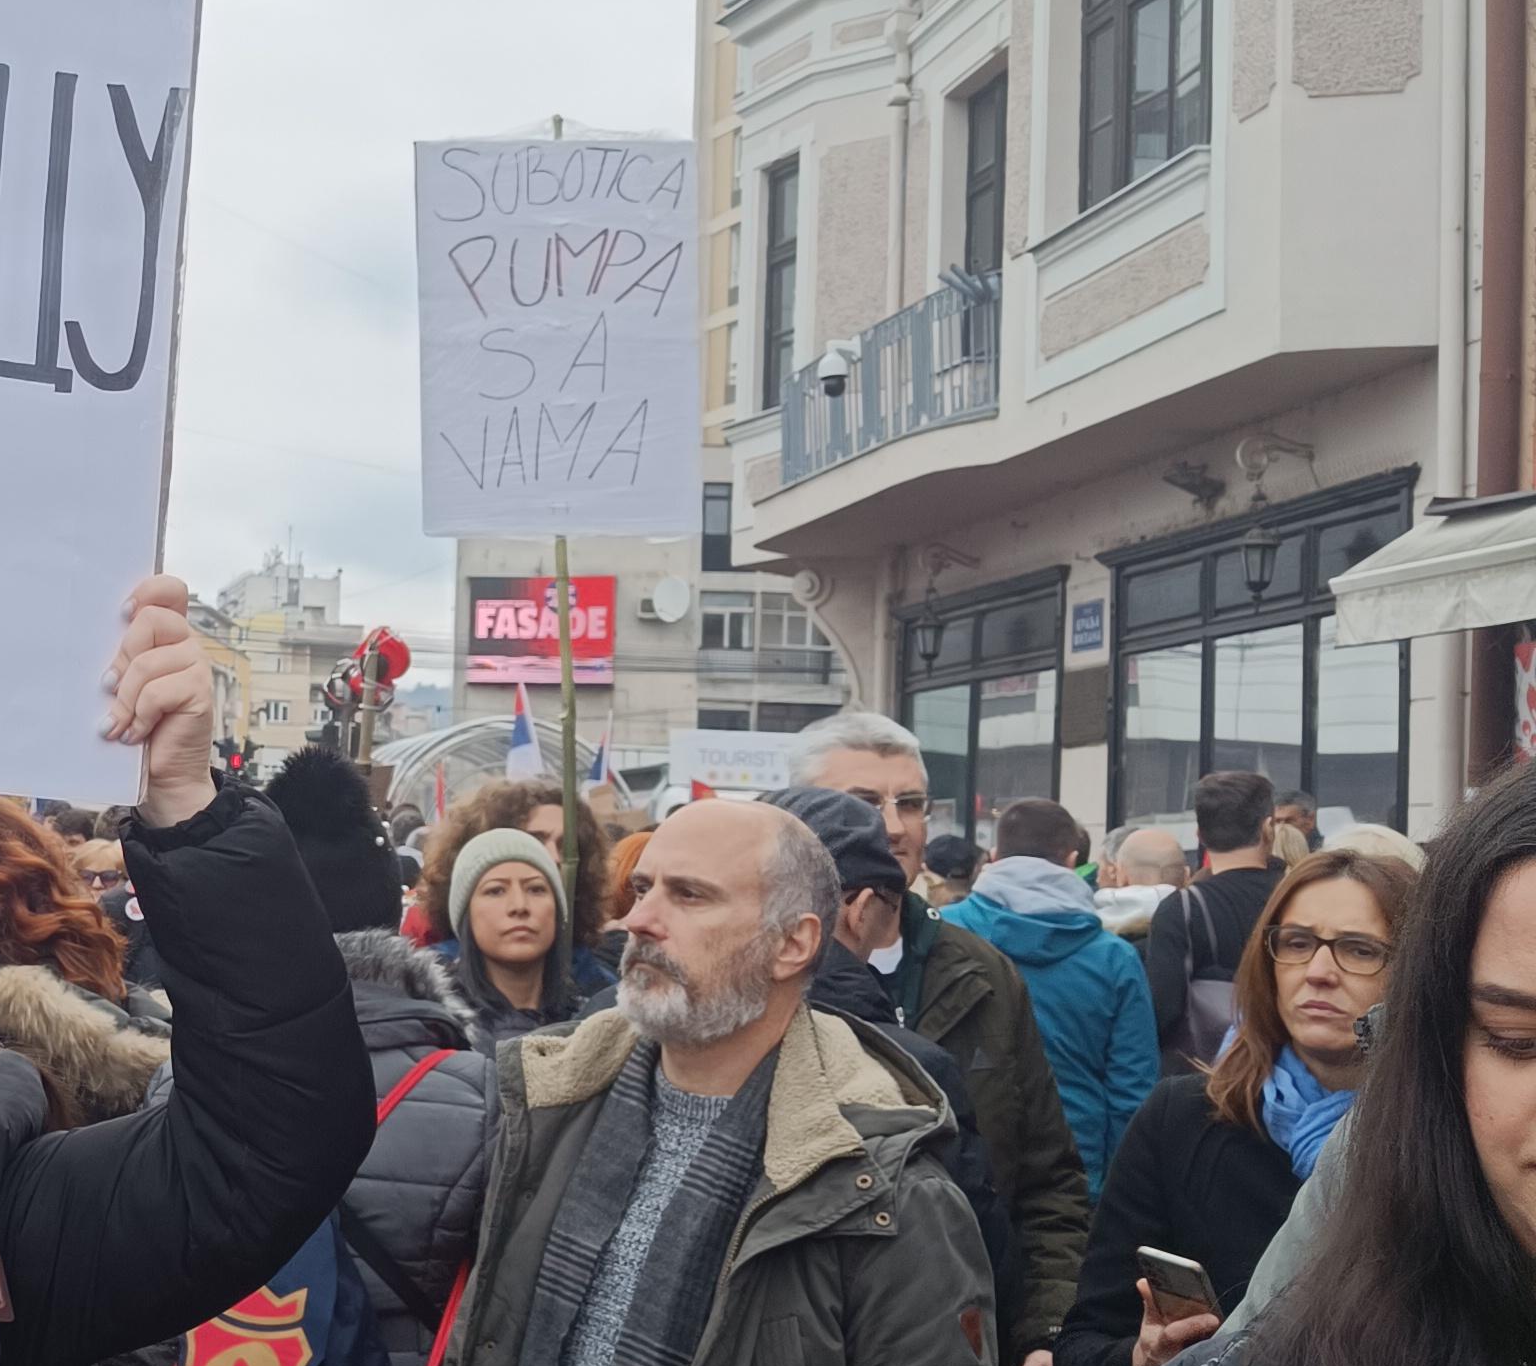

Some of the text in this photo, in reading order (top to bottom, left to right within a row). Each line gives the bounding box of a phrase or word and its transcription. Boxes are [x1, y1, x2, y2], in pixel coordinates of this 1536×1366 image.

[433, 145, 685, 222] SUBOTICA
[448, 227, 683, 319] PUMPA
[478, 310, 608, 401] SA
[439, 398, 648, 490] VAMA
[475, 605, 608, 640] FASADE
[697, 748, 779, 767] TOURIST
